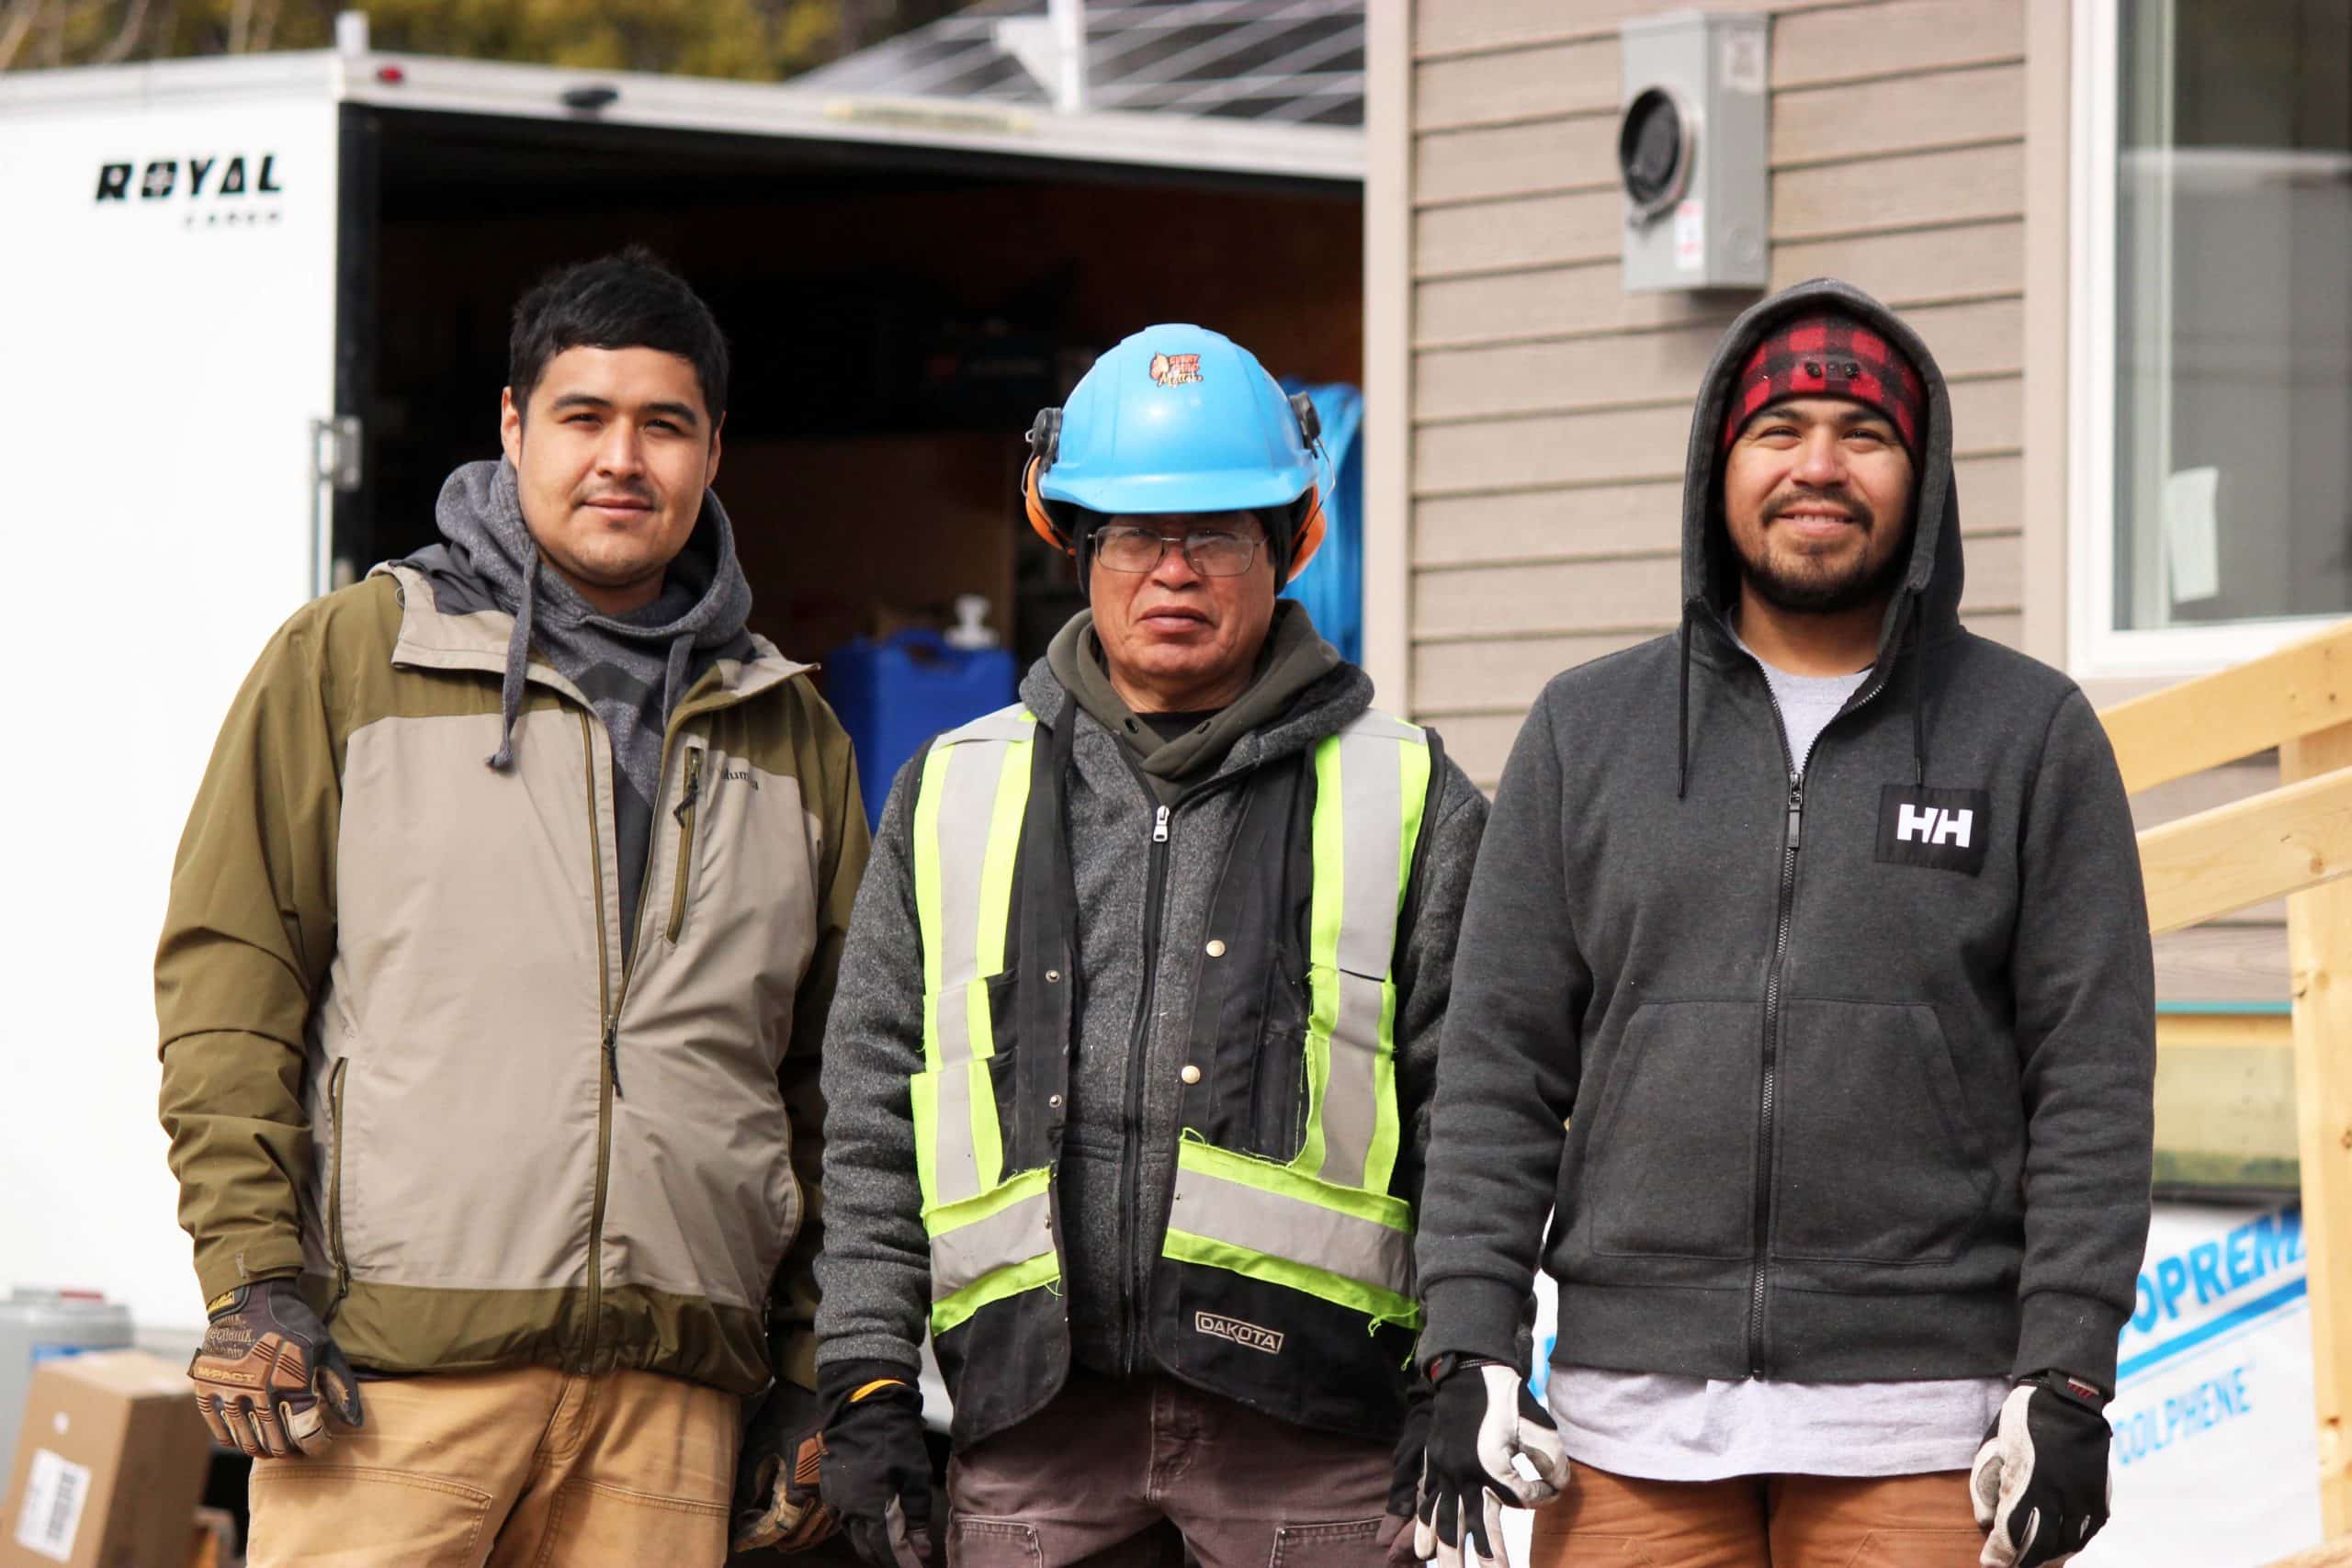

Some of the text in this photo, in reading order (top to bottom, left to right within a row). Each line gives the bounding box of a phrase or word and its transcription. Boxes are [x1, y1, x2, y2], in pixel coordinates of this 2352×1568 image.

[96, 155, 281, 199] ROYAL
[1896, 803, 1973, 848] HH
[2117, 1205, 2307, 1342] OPREM
[1199, 1315, 1277, 1348] DAKOTA
